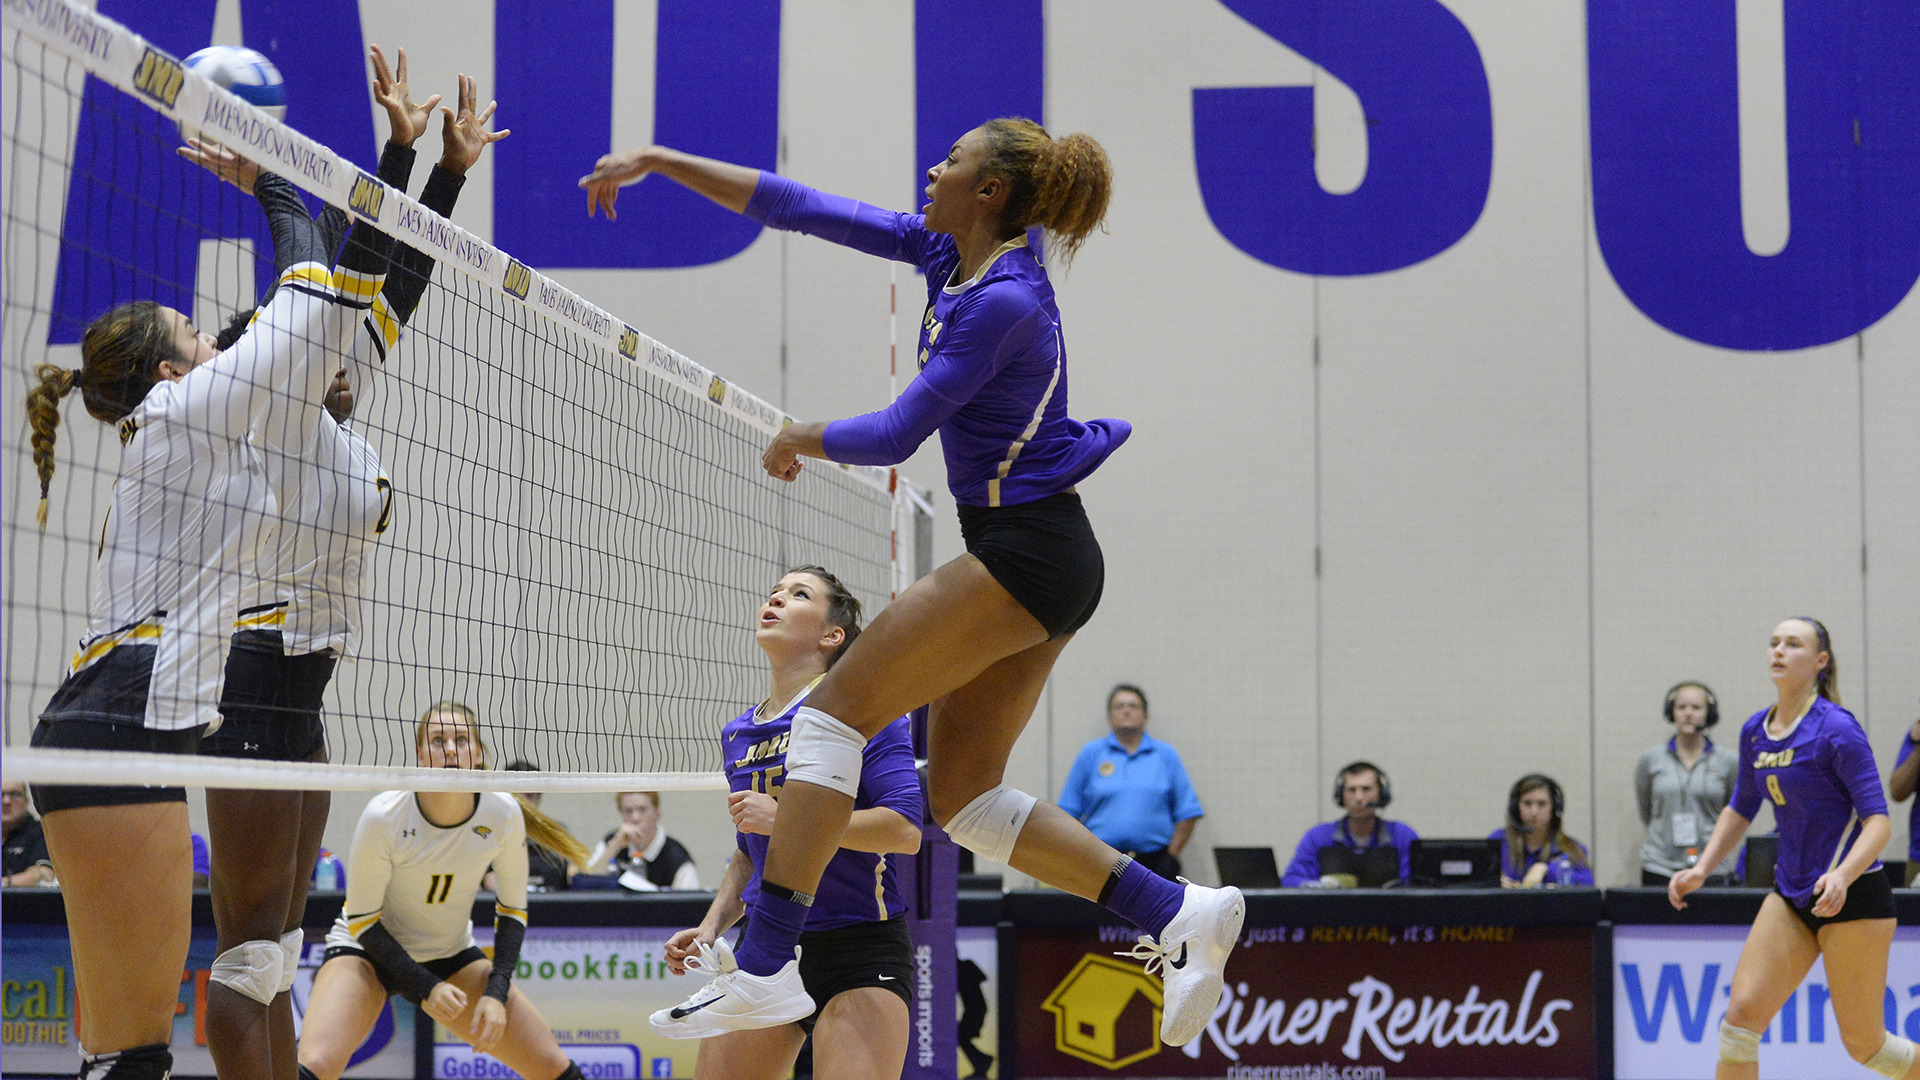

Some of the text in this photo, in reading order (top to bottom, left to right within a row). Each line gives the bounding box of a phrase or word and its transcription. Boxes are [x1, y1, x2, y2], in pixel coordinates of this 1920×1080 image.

[349, 173, 385, 222] JMU
[1752, 747, 1796, 770] JMU
[1765, 774, 1787, 807] 8
[425, 873, 455, 905] 11
[516, 953, 668, 980] bookfair
